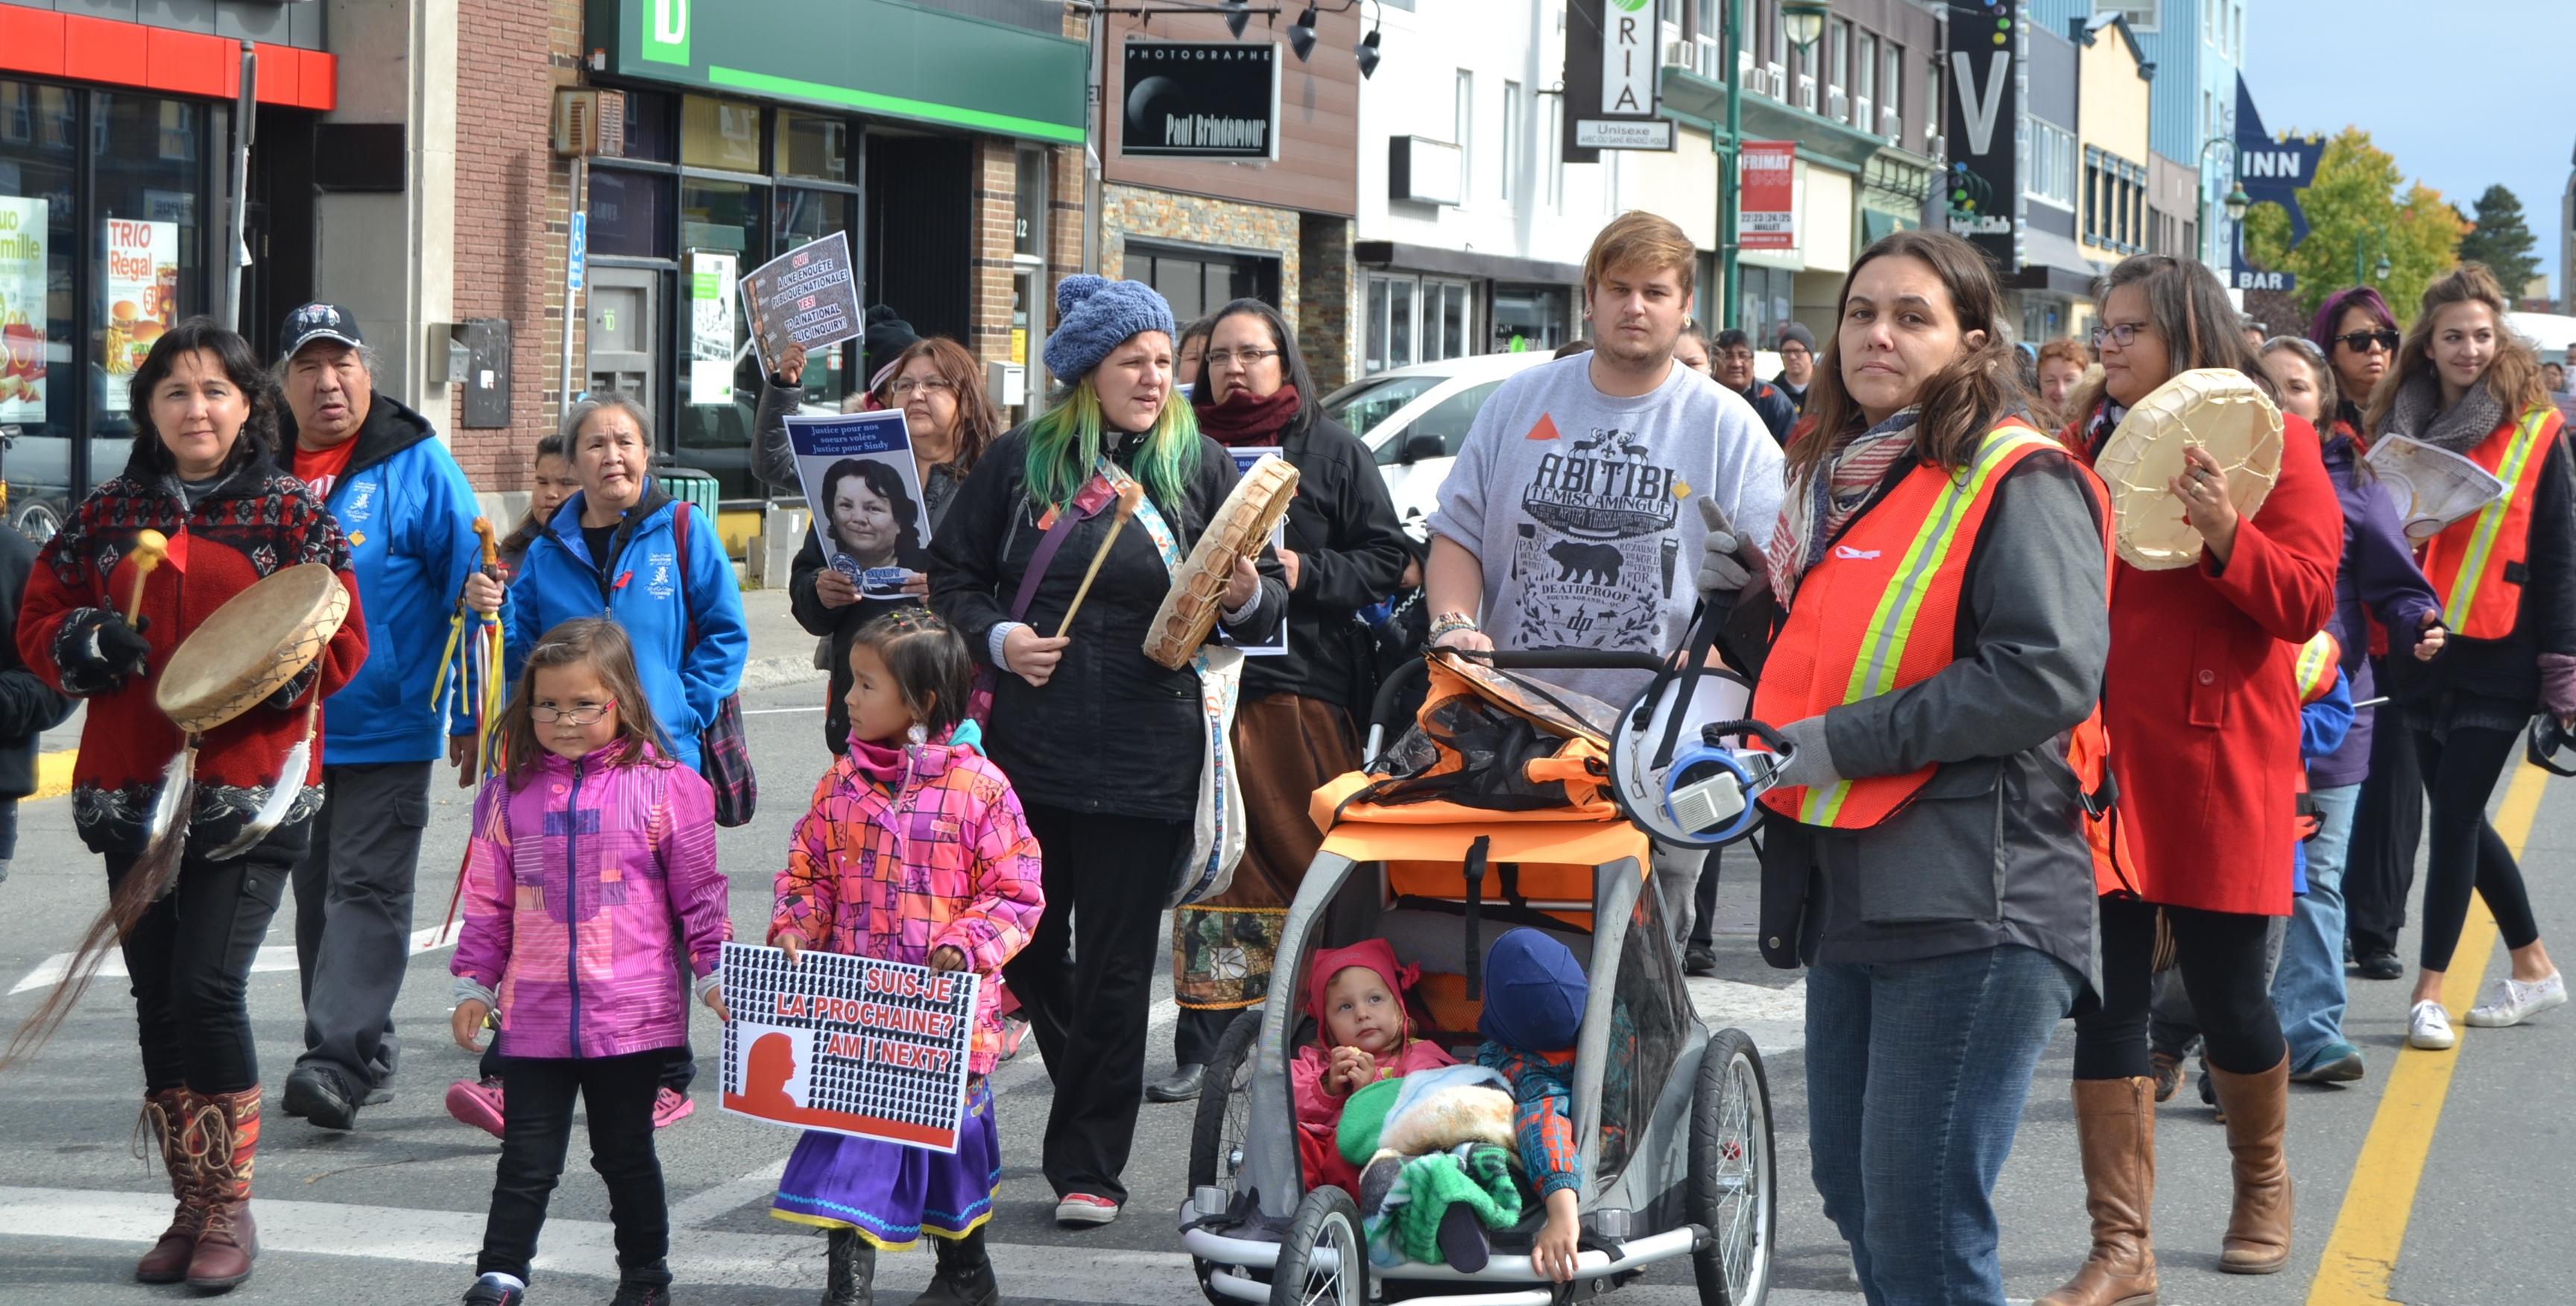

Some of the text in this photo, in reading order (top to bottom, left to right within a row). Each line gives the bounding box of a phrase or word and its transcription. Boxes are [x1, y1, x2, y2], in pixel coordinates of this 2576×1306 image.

[1128, 49, 1270, 60] PHOTOGRAPHE
[1951, 51, 2010, 155] V
[1165, 113, 1266, 148] Paul Brindamour
[1598, 124, 1650, 135] Unisexe
[2242, 151, 2300, 177] INN
[2220, 110, 2233, 244] CHATAU
[110, 221, 152, 248] TRIO
[1016, 218, 1027, 237] 12
[111, 250, 152, 282] Régal
[793, 252, 809, 268] OUI!
[783, 273, 797, 286] UNE
[798, 259, 833, 280] ENQUÊTE
[2239, 271, 2283, 289] BAR
[771, 269, 848, 309] PUBLIQUE NATIONALE!
[794, 317, 801, 326] A
[801, 303, 841, 324] NATIONAL
[798, 295, 815, 310] YES!
[789, 329, 812, 342] BLIC
[811, 318, 847, 337] INQUIRY!
[811, 426, 839, 436] Justice
[841, 427, 862, 436] pour
[848, 432, 877, 441] volées
[812, 441, 889, 454] Justice pour Sindy
[1534, 453, 1675, 502] ABITIBI
[1530, 485, 1672, 516] TEMISCAMINGUE
[1620, 543, 1660, 555] ROYAUME
[865, 568, 900, 578] SINDY
[1542, 584, 1631, 602] DEATHPROOF
[866, 968, 953, 1003] SUIS-JE
[776, 993, 954, 1038] LA PROCHAINE?
[827, 1033, 950, 1073] AM I NEXT?
